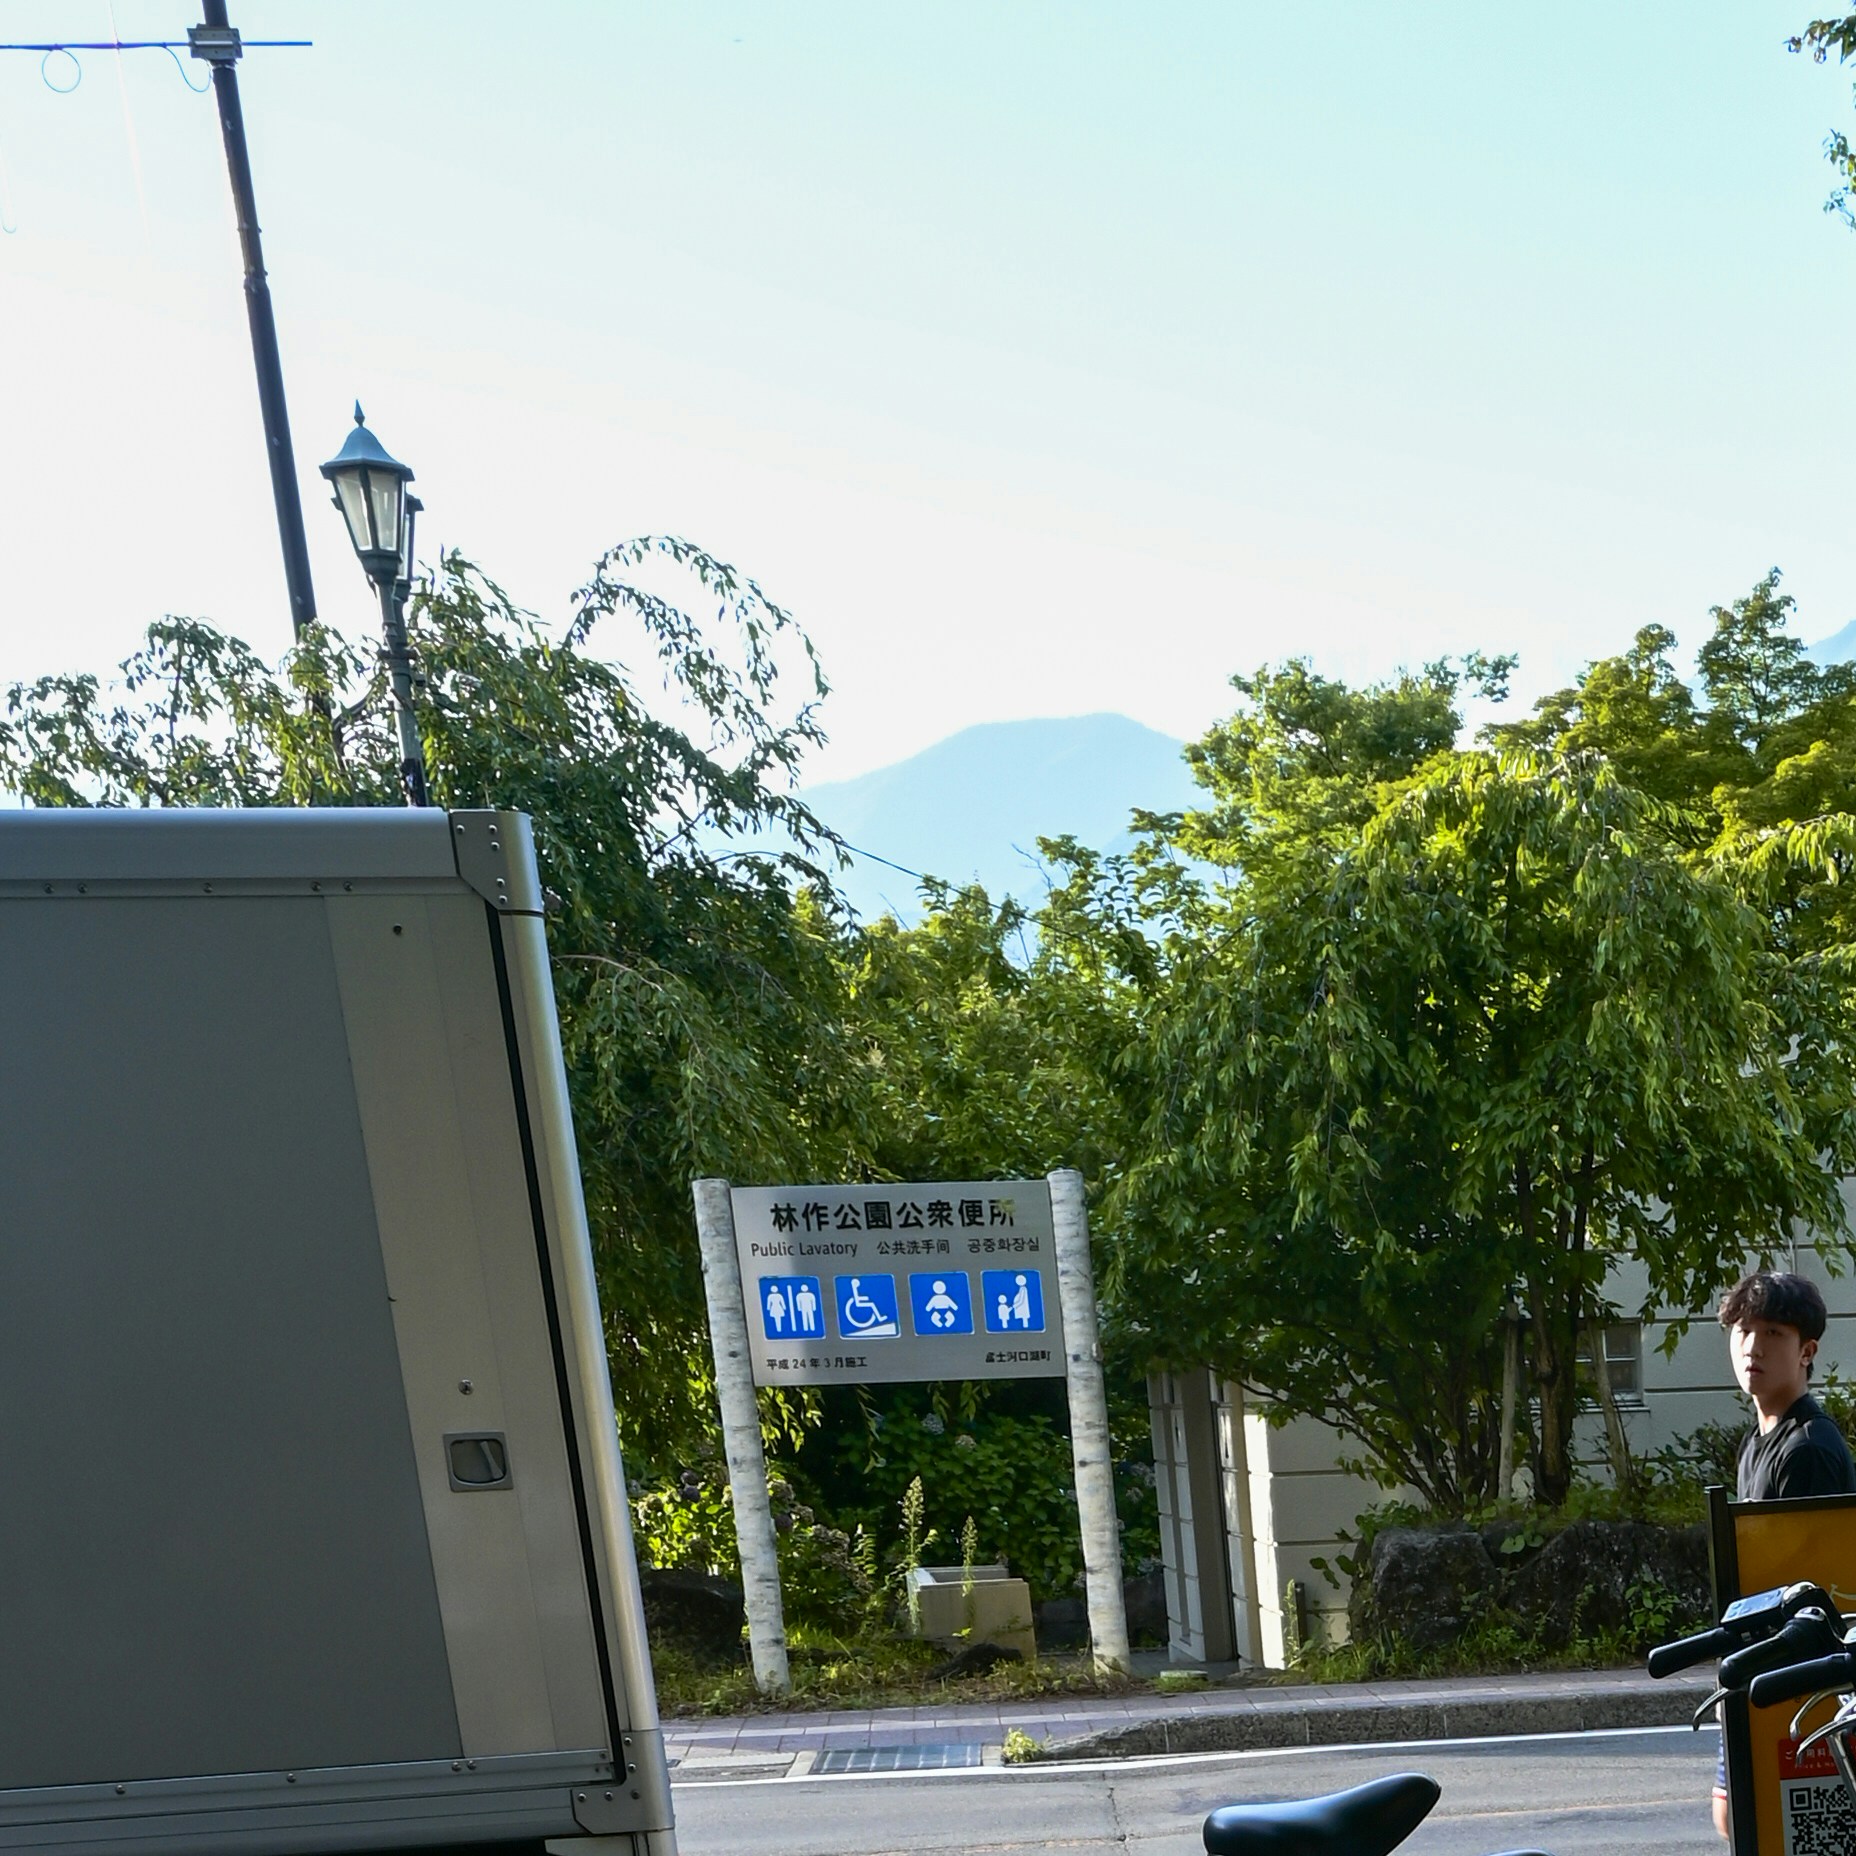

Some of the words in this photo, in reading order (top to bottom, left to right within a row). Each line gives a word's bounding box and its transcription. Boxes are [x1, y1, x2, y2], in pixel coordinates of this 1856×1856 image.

[770, 1199, 1015, 1233] 林作公園公衆便所
[751, 1241, 795, 1257] Public
[799, 1241, 858, 1258] Lavatory
[876, 1239, 950, 1256] 公共洗手间
[967, 1237, 1040, 1254] 공중화장실
